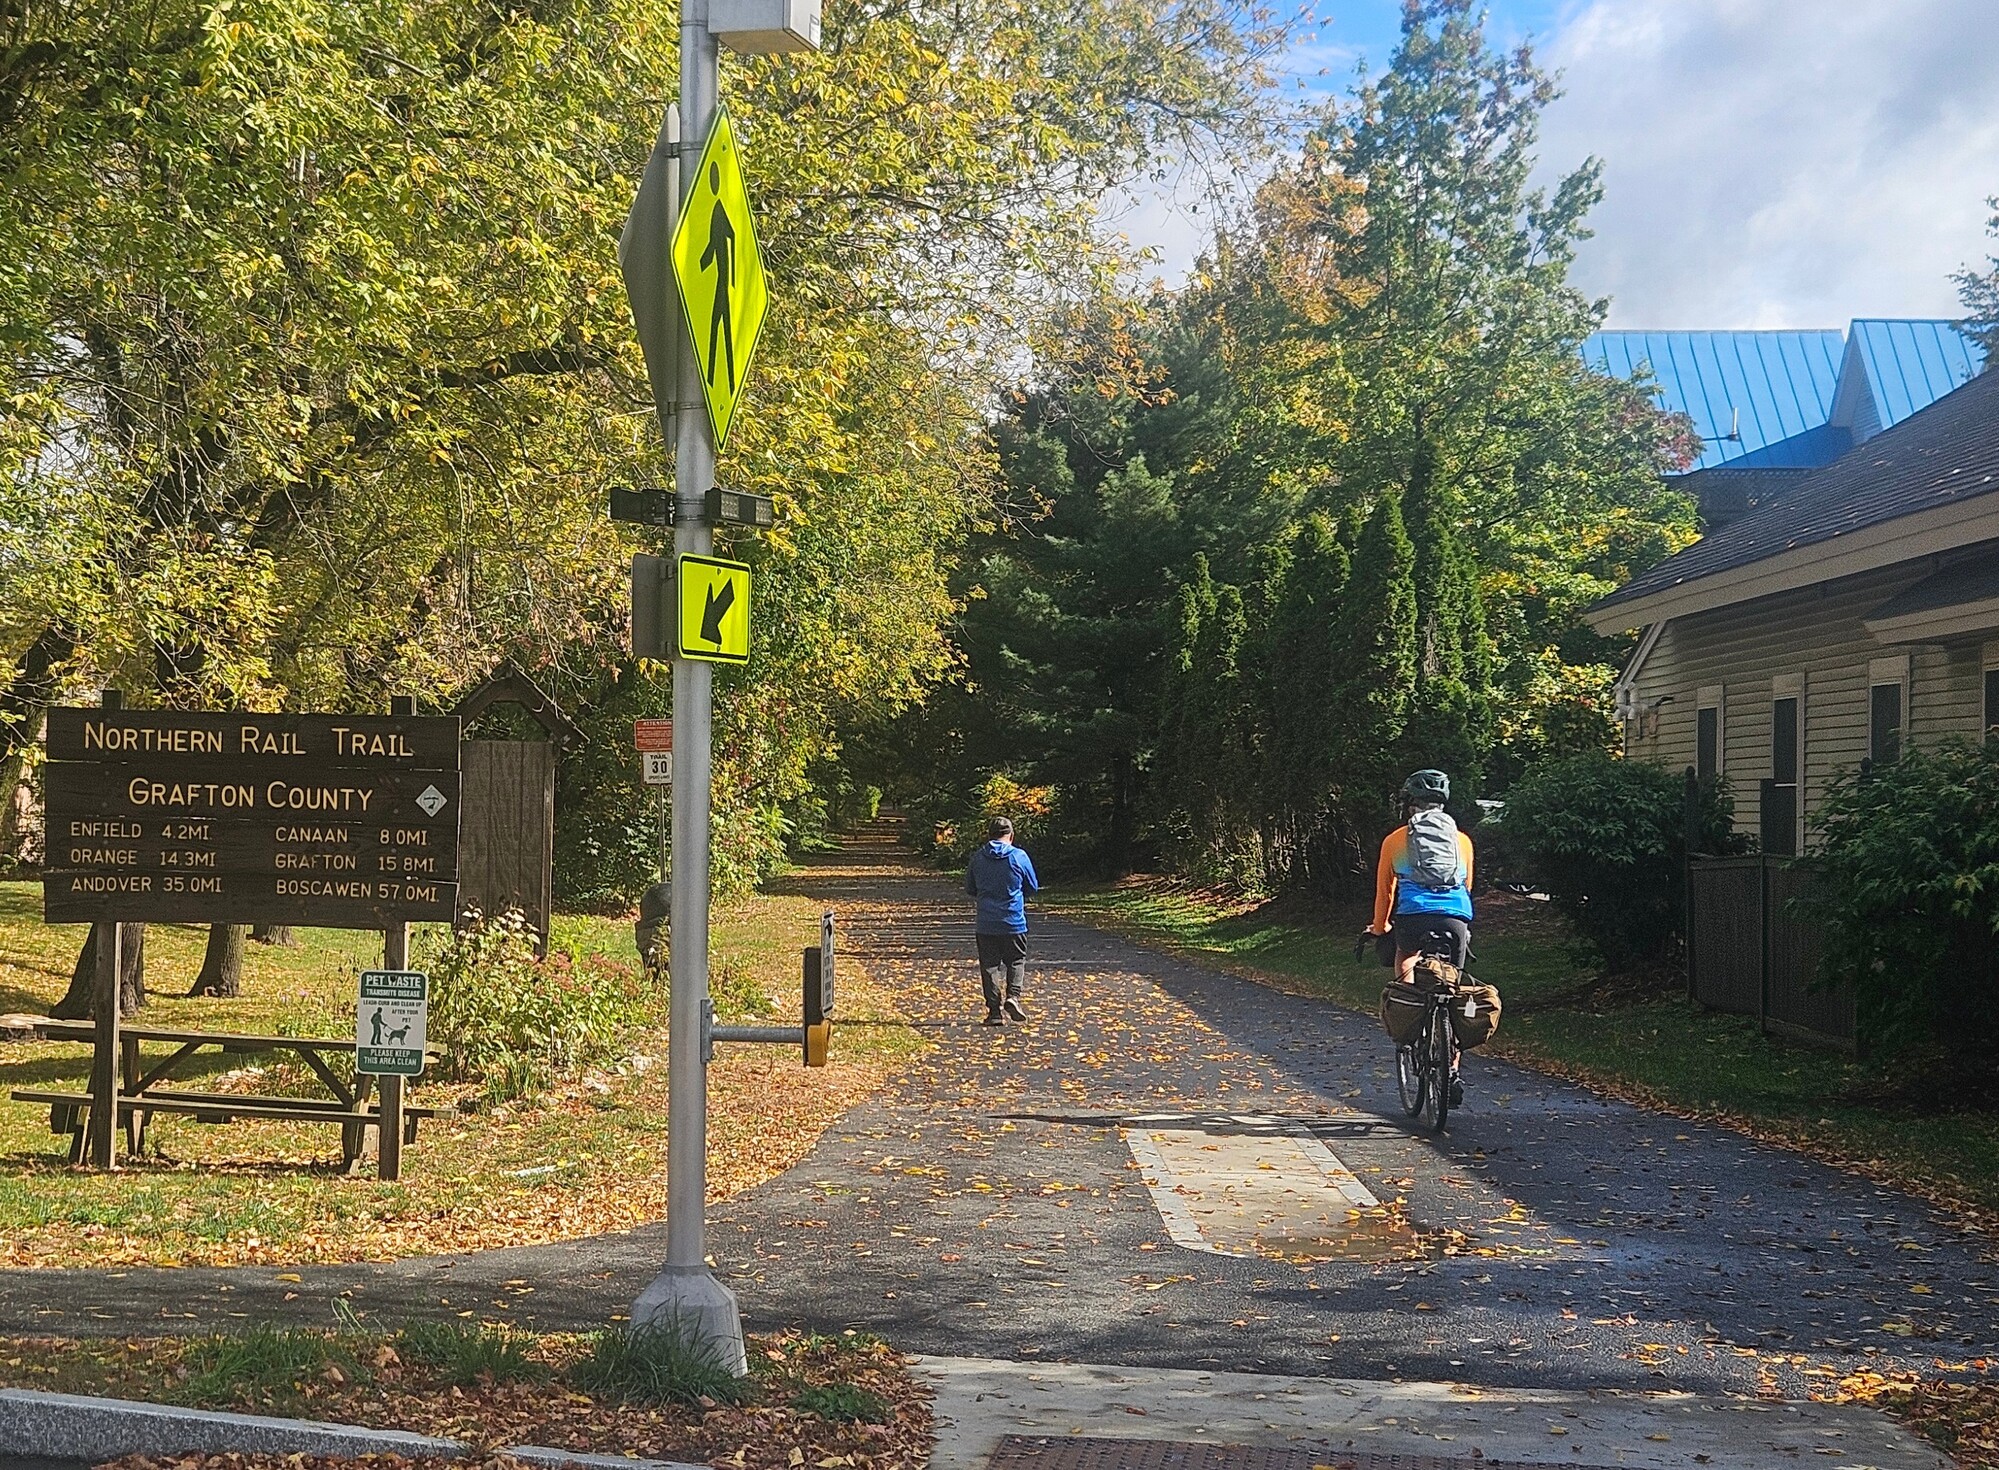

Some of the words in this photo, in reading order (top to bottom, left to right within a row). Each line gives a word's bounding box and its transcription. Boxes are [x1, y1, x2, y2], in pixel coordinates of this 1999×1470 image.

[84, 722, 223, 753] NORTHERN
[241, 726, 306, 755] RAIL
[331, 727, 414, 757] TRAIL
[652, 760, 667, 774] 30
[128, 778, 254, 808] GRAFTON
[266, 780, 373, 811] COUNTY
[70, 822, 142, 838] ENFIELD
[275, 827, 348, 843] CANAAN
[70, 849, 138, 865] ORANGE
[275, 854, 356, 870] GRAFTON
[71, 877, 152, 892] ANDOVER
[276, 879, 372, 898] BOSCAWEN
[366, 975, 385, 986] PET
[366, 989, 396, 997] TRANSMITS
[398, 990, 420, 998] DISEASE
[364, 1056, 377, 1064] THIS
[397, 1058, 417, 1066] CLEAN
[370, 1049, 393, 1057] PLEASE
[395, 1050, 410, 1058] KEEP
